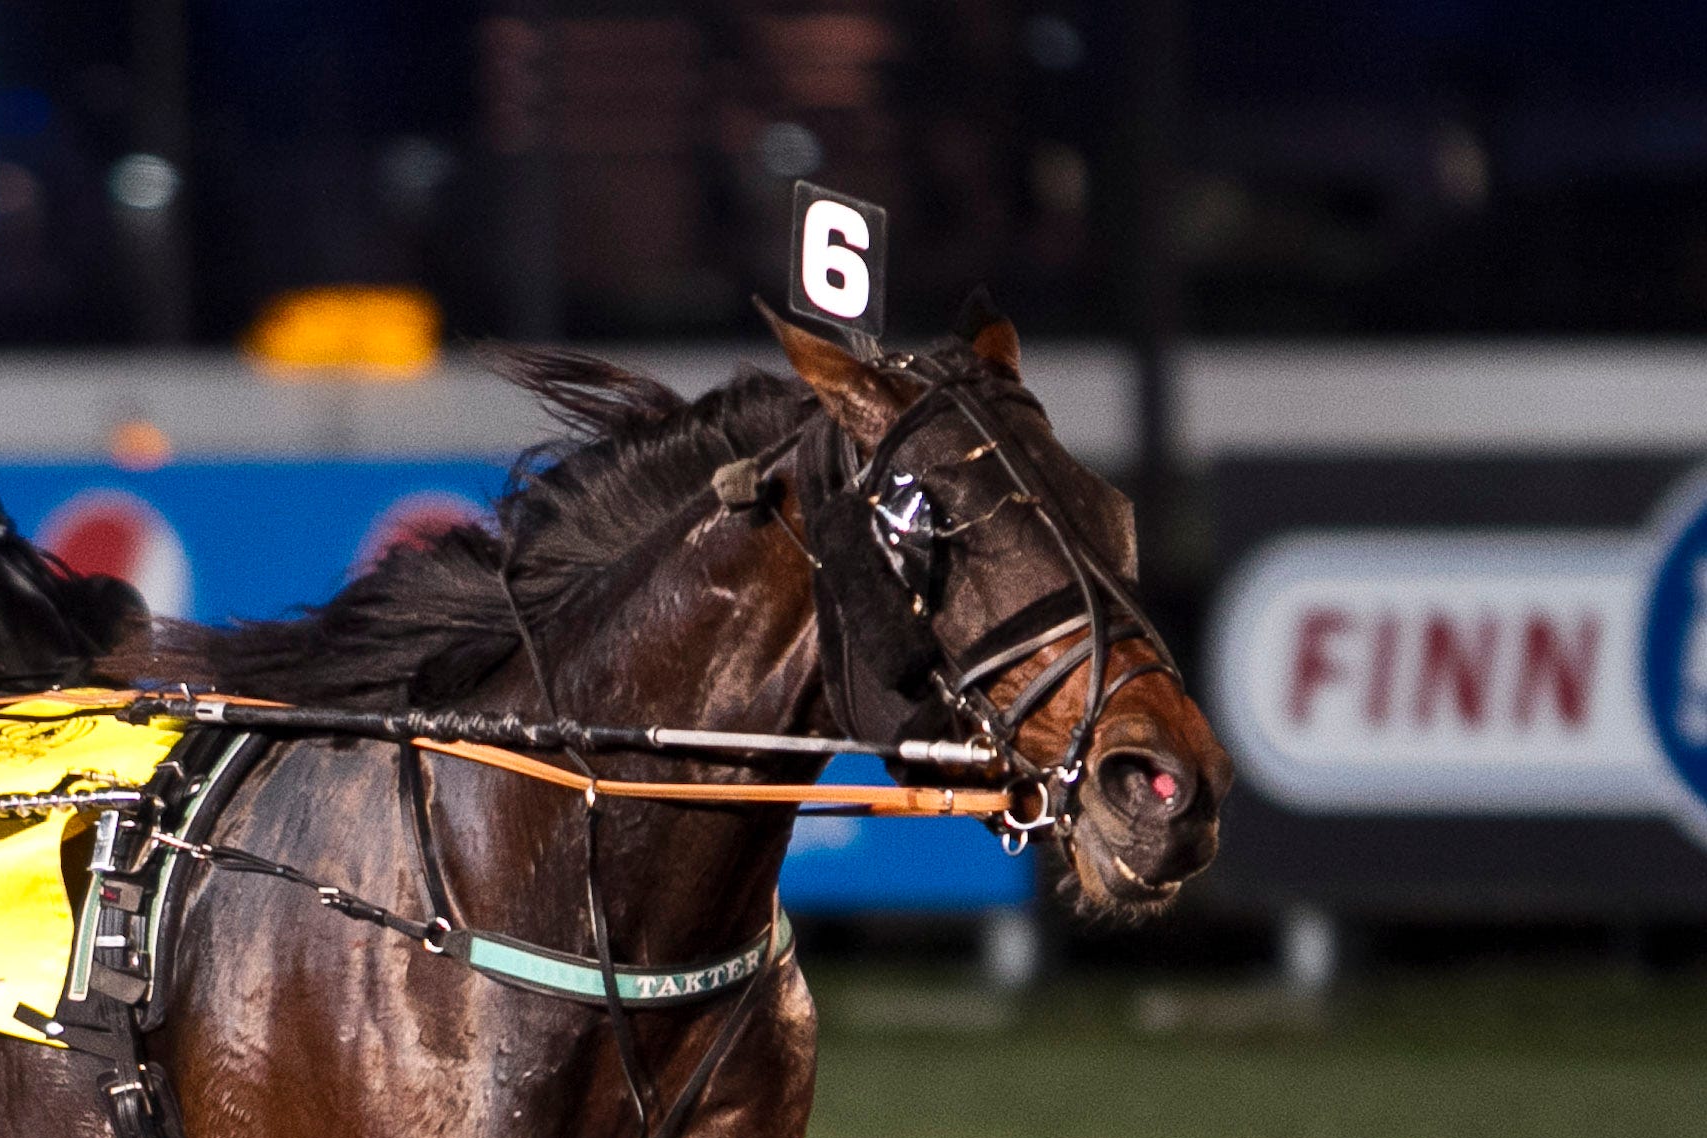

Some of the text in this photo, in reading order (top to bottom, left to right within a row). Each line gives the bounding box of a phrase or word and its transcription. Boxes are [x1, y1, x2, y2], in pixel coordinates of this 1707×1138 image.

[801, 199, 870, 319] 6
[1284, 606, 1602, 732] FINN
[635, 947, 762, 1000] TAKTER
